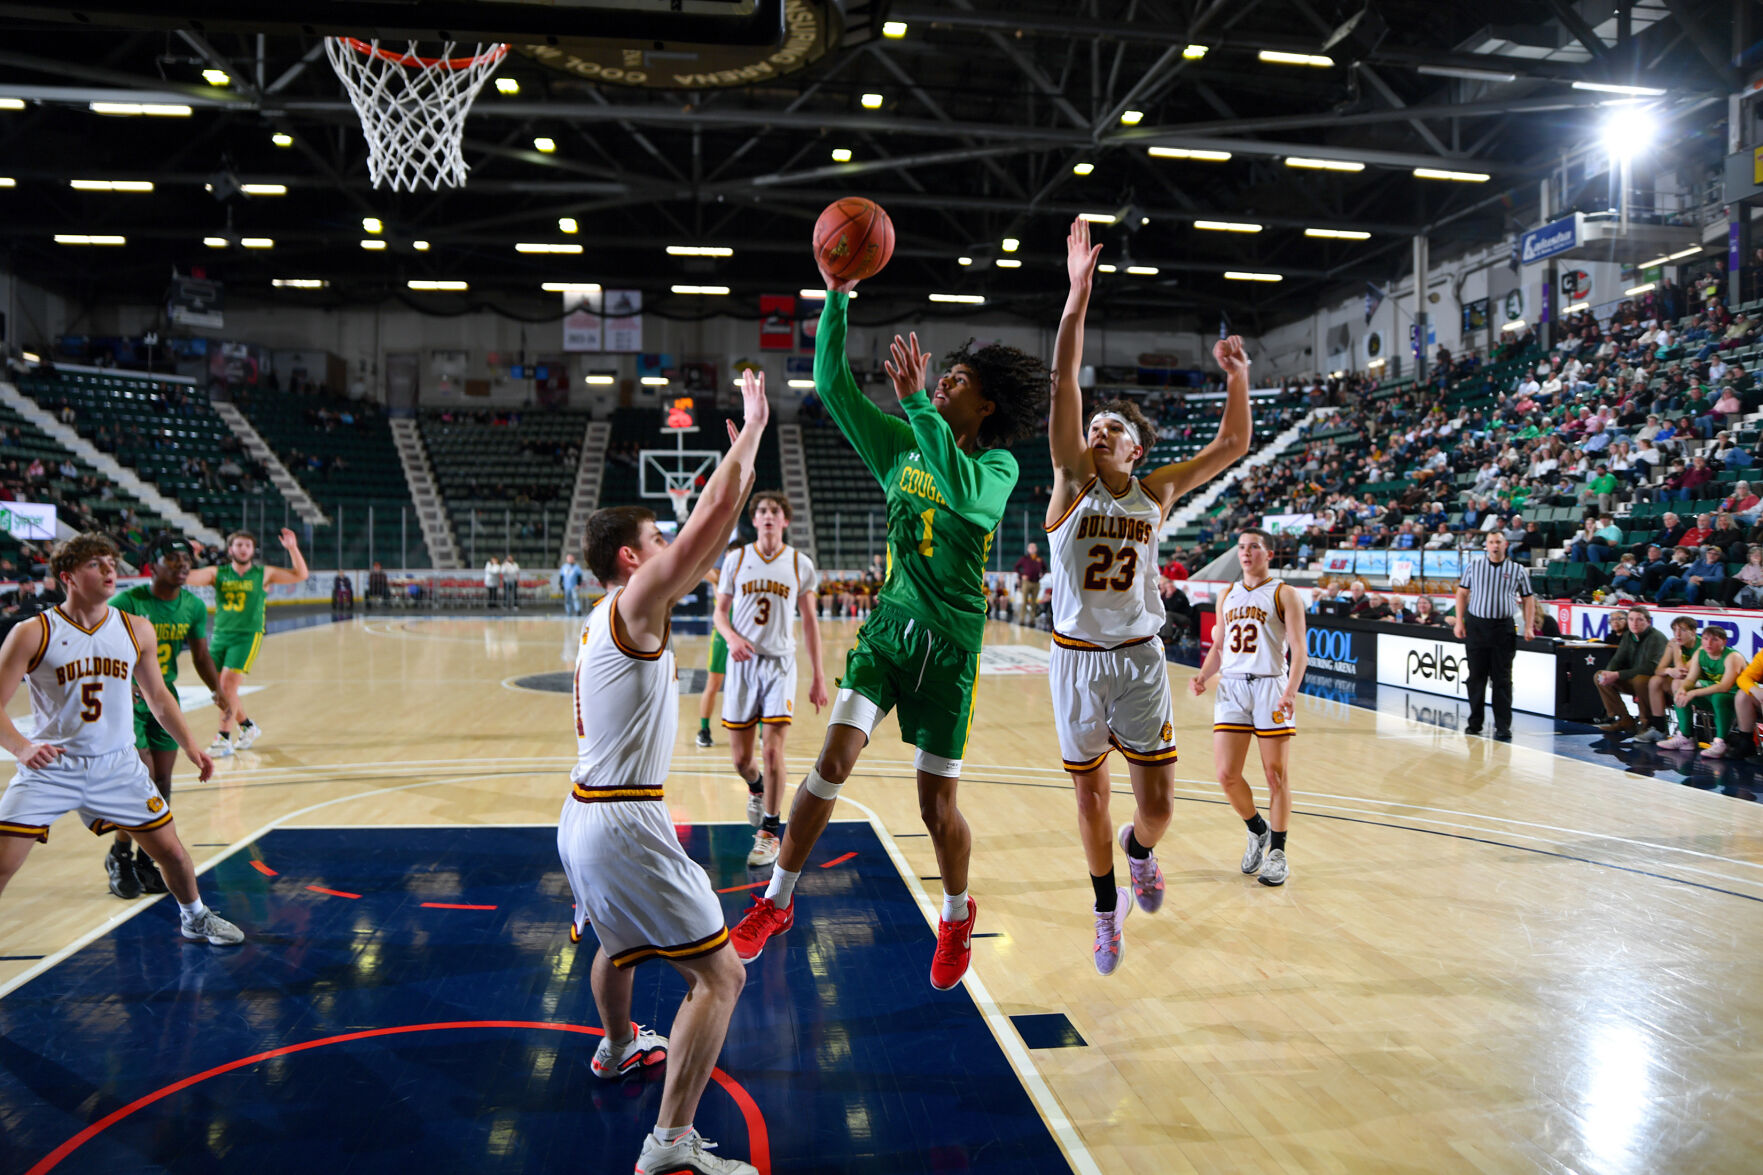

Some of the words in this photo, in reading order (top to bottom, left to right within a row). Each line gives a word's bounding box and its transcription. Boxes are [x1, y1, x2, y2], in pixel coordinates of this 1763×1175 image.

[565, 56, 648, 84] COOL
[672, 60, 774, 86] ARENA
[918, 508, 936, 558] 1
[1077, 514, 1152, 545] BULLDOGS
[1083, 543, 1138, 592] 23
[222, 592, 247, 612] 33
[741, 578, 790, 600] BULLDOGS
[754, 596, 771, 627] 3
[1230, 623, 1258, 654] 32
[1305, 627, 1359, 664] COOL
[55, 656, 129, 687] BULLDOGS
[1333, 661, 1357, 675] ARENA
[80, 682, 104, 724] 5
